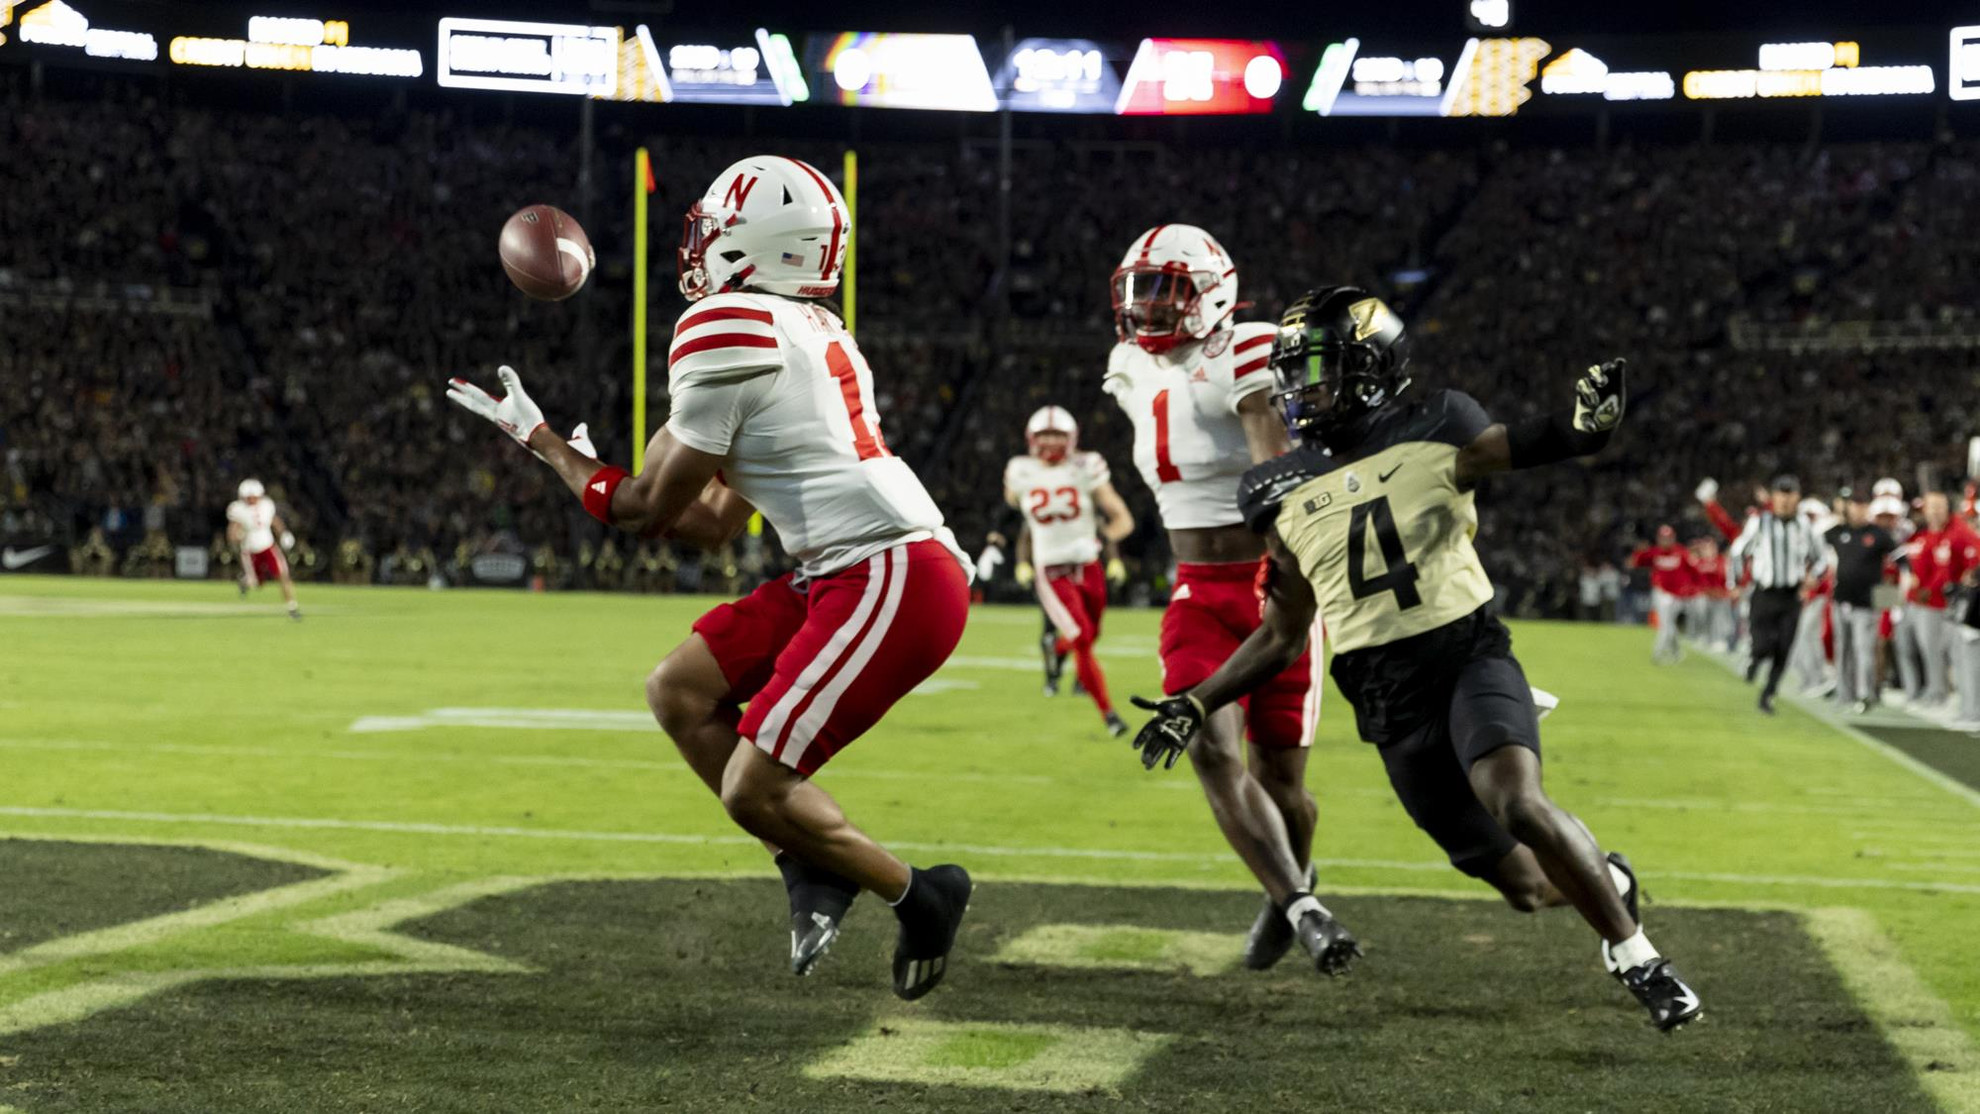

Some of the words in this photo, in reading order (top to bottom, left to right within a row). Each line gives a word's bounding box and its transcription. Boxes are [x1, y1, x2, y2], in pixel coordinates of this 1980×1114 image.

[723, 173, 759, 212] N
[1153, 389, 1182, 483] 1
[1030, 486, 1081, 524] 23
[1348, 496, 1422, 610] 4
